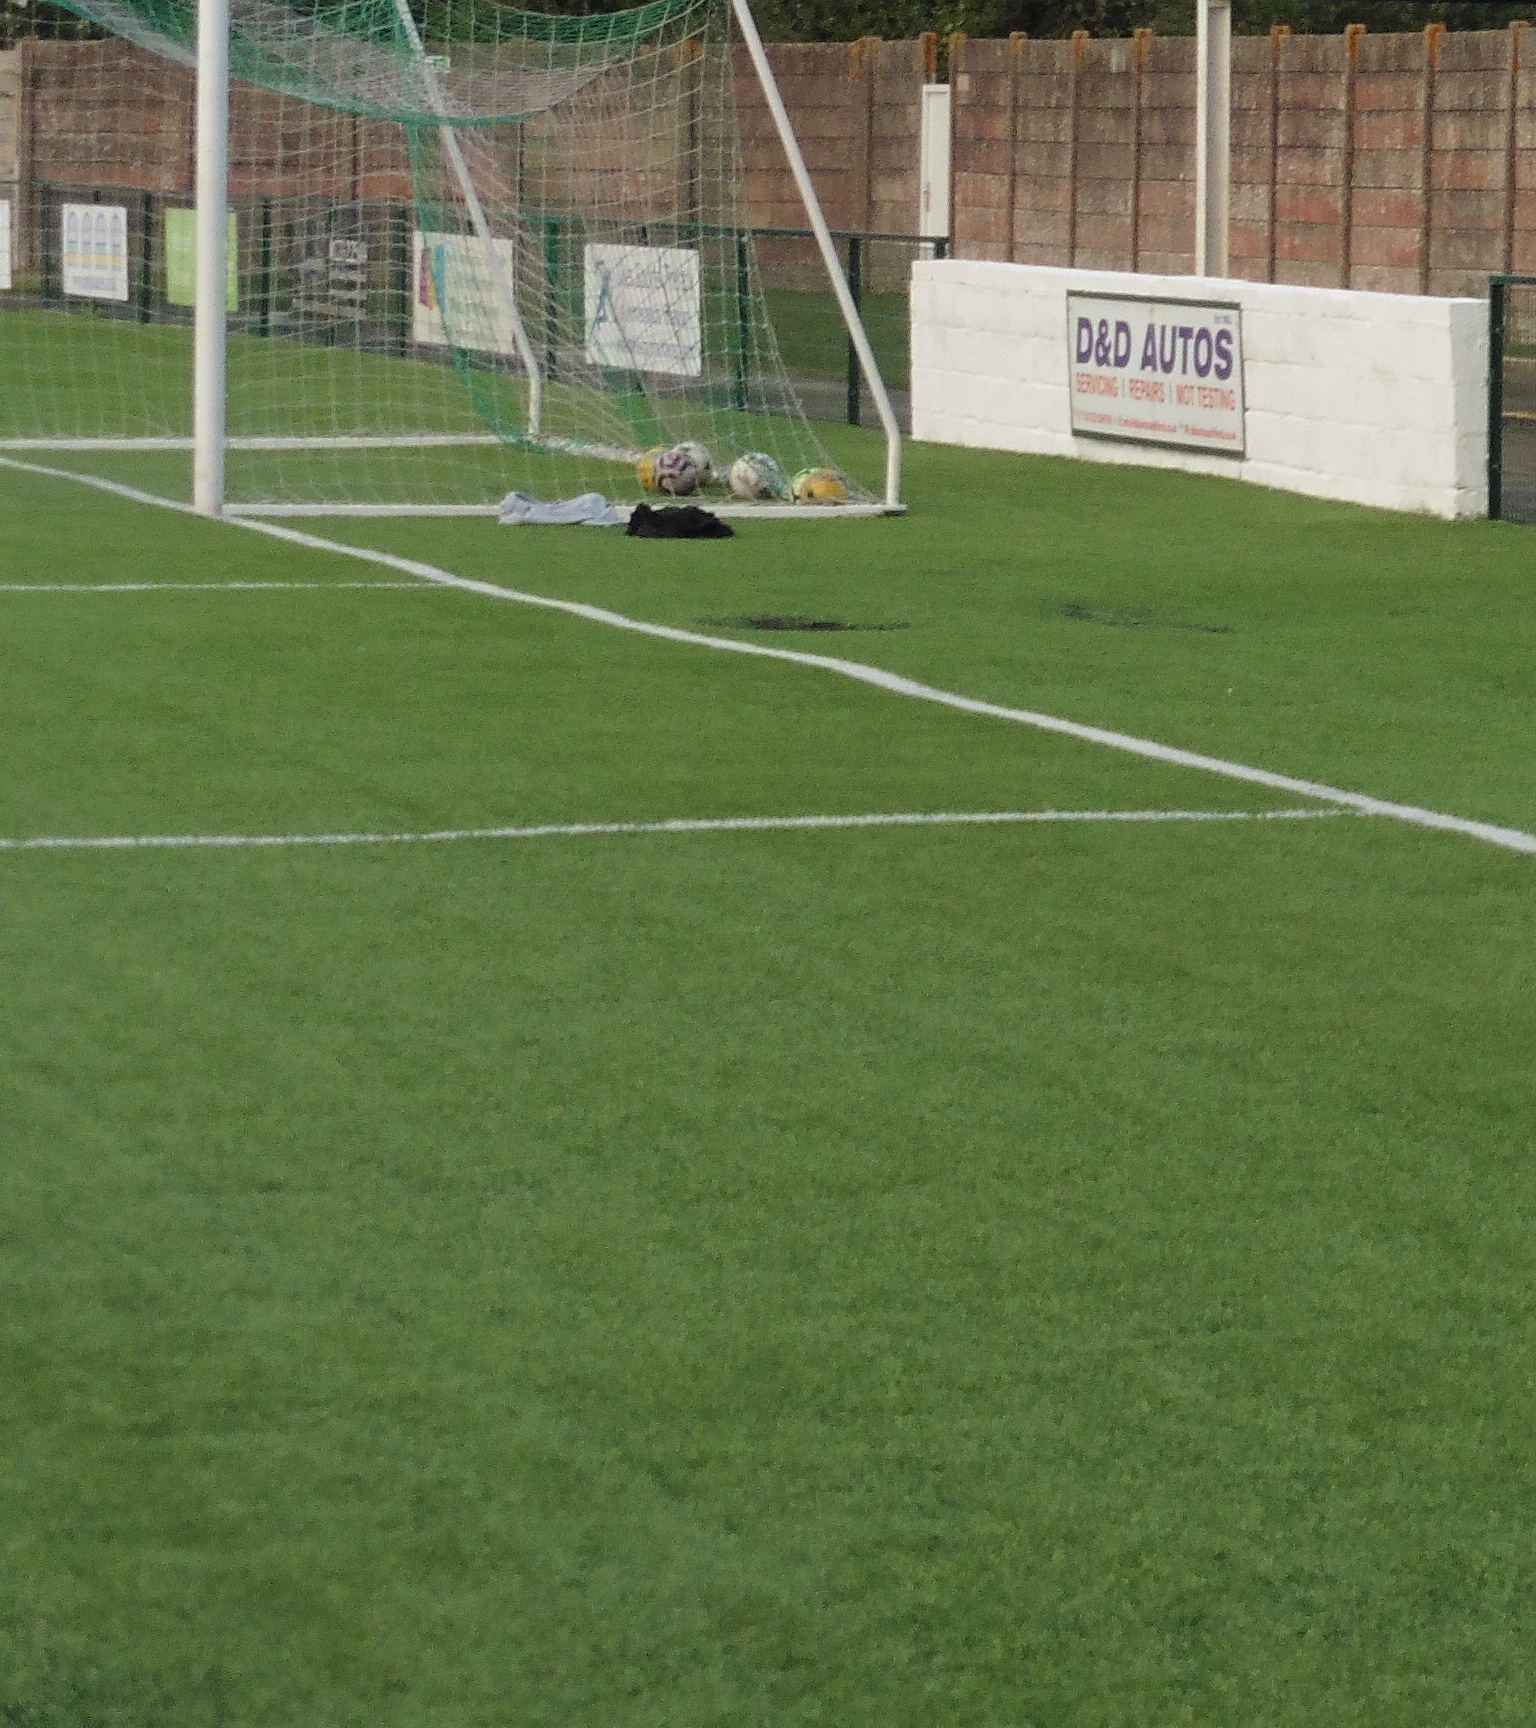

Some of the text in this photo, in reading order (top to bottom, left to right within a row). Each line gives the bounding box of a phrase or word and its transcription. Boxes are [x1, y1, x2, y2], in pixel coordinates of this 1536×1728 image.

[1076, 317, 1234, 381] D&D AUTOS
[1197, 386, 1235, 411] TESTING
